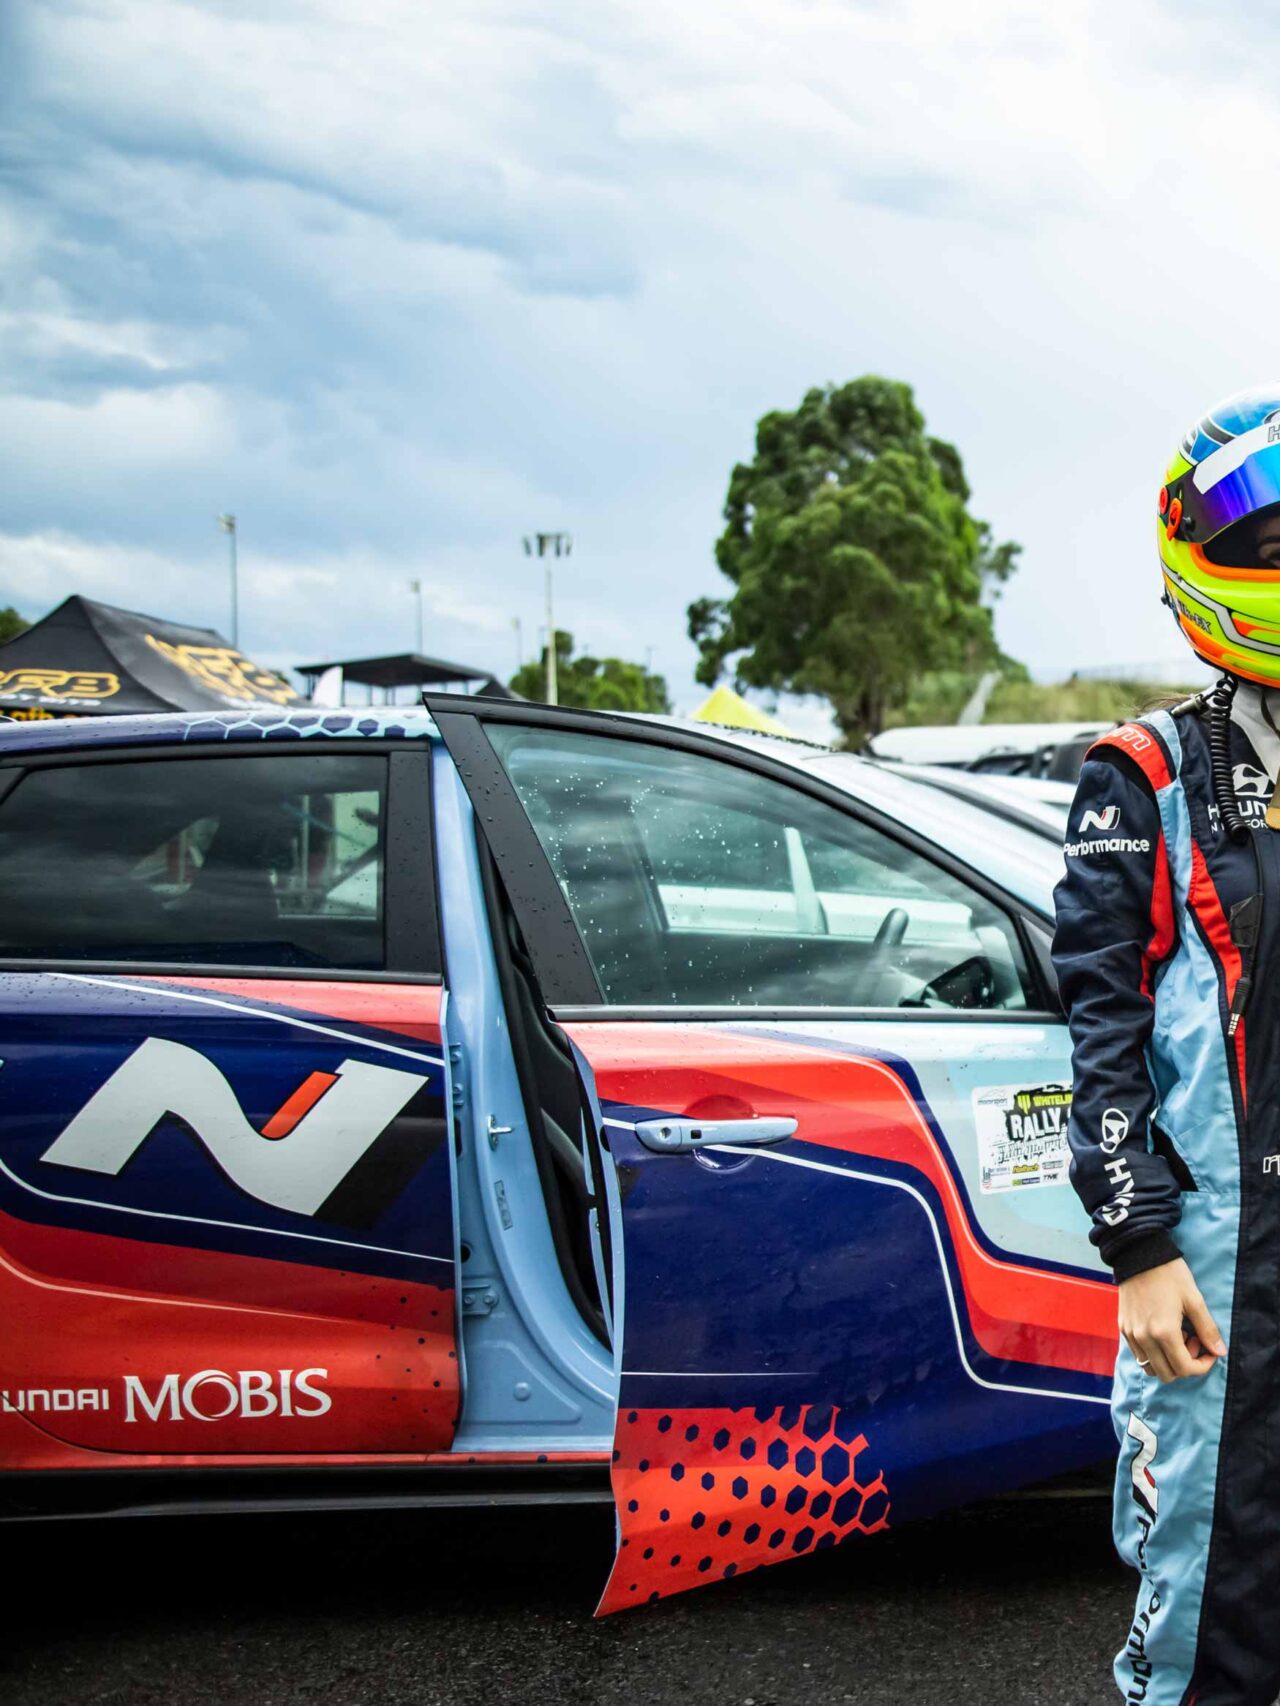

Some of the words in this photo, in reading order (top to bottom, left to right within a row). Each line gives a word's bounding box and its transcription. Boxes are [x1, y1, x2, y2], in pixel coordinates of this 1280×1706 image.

[1010, 1107, 1061, 1141] RALLY
[2, 1388, 110, 1412] UNDAI
[124, 1368, 332, 1422] MOBIS
